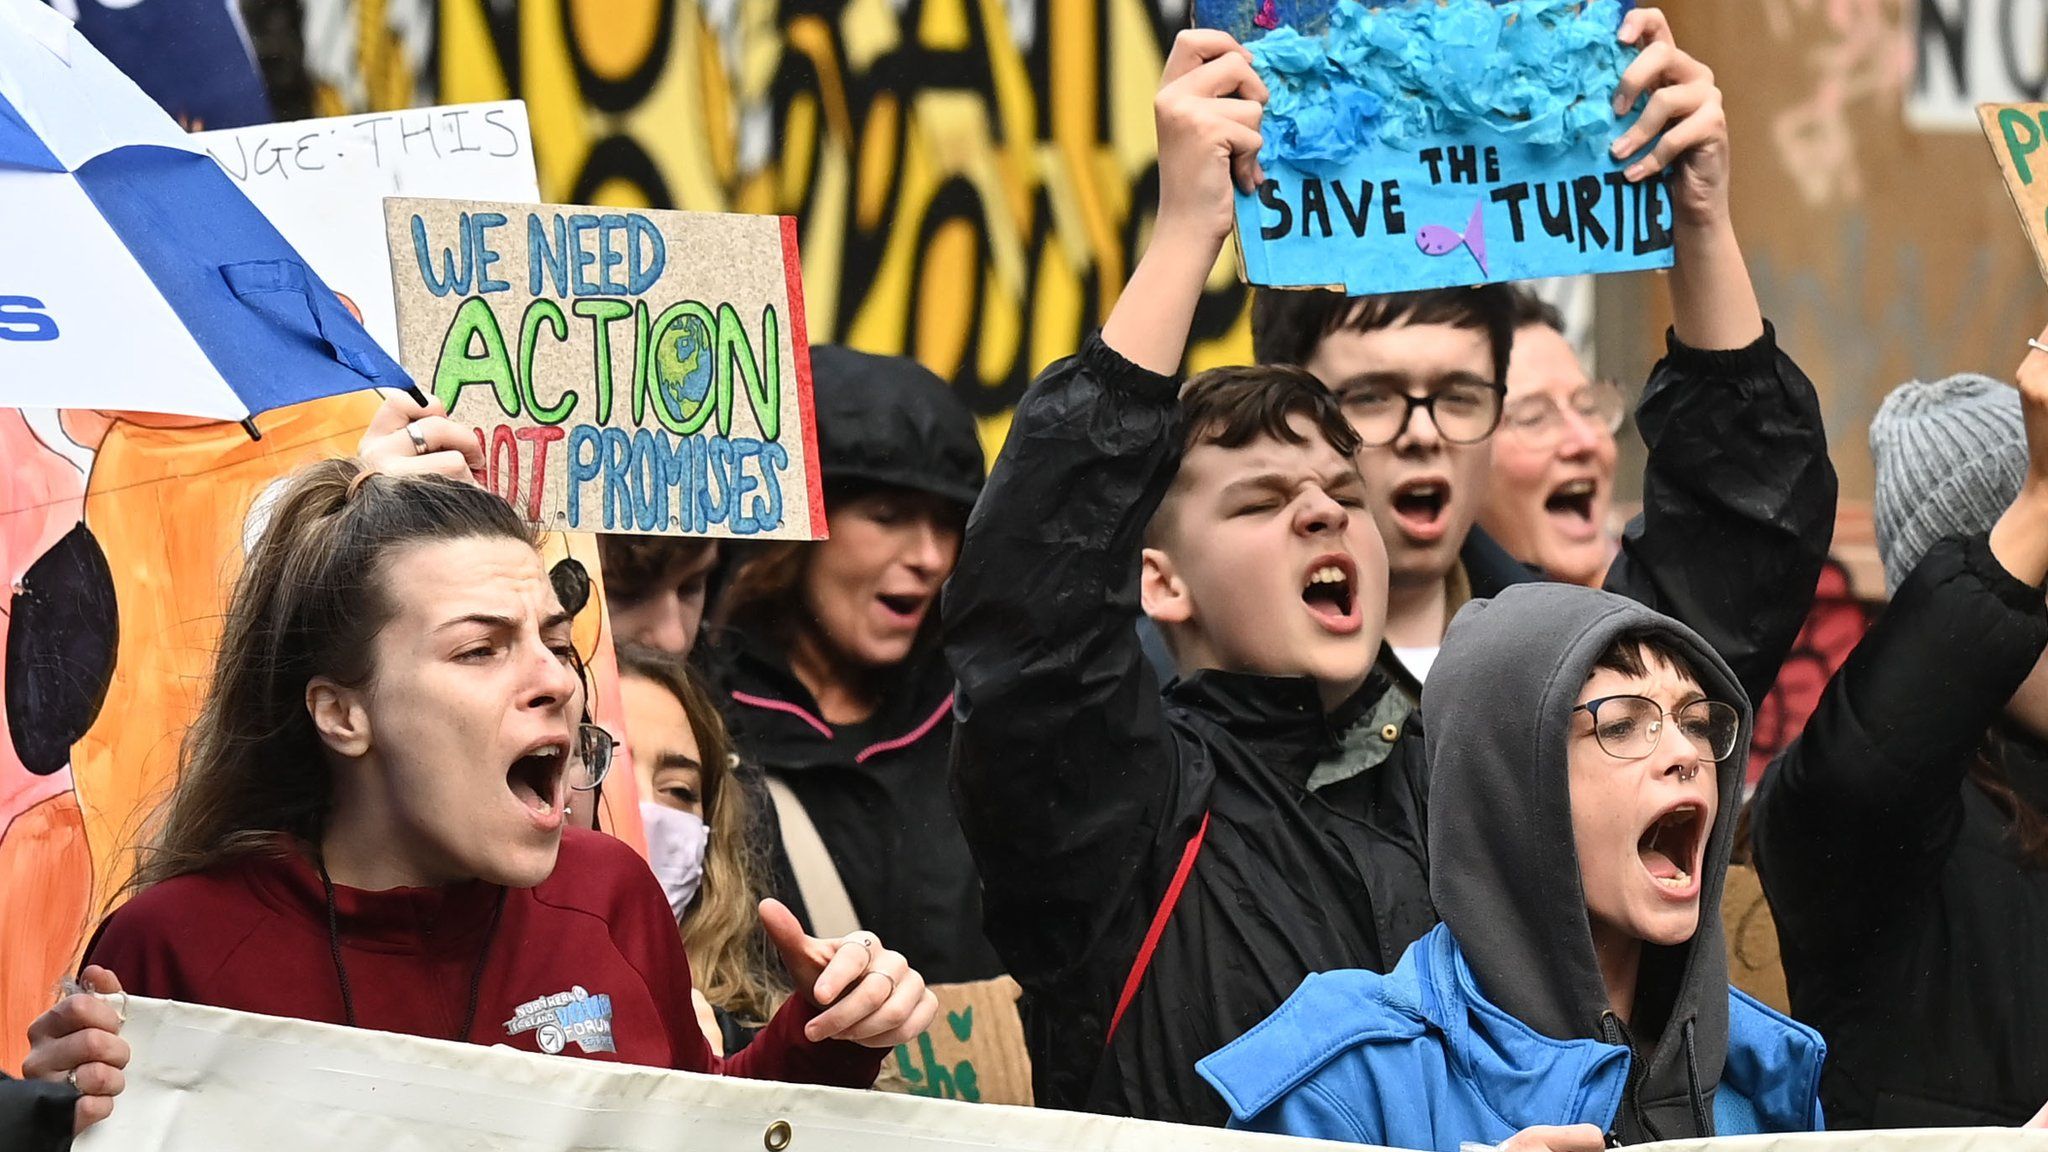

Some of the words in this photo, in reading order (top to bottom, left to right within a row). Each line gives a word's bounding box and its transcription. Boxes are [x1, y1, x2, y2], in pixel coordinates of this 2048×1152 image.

[353, 109, 519, 168] THIS
[1419, 144, 1501, 185] THE
[1258, 178, 1406, 241] SAVE
[410, 211, 511, 298] WE
[527, 212, 667, 299] NEED
[430, 295, 781, 443] ACTION
[566, 424, 788, 535] PROMISES
